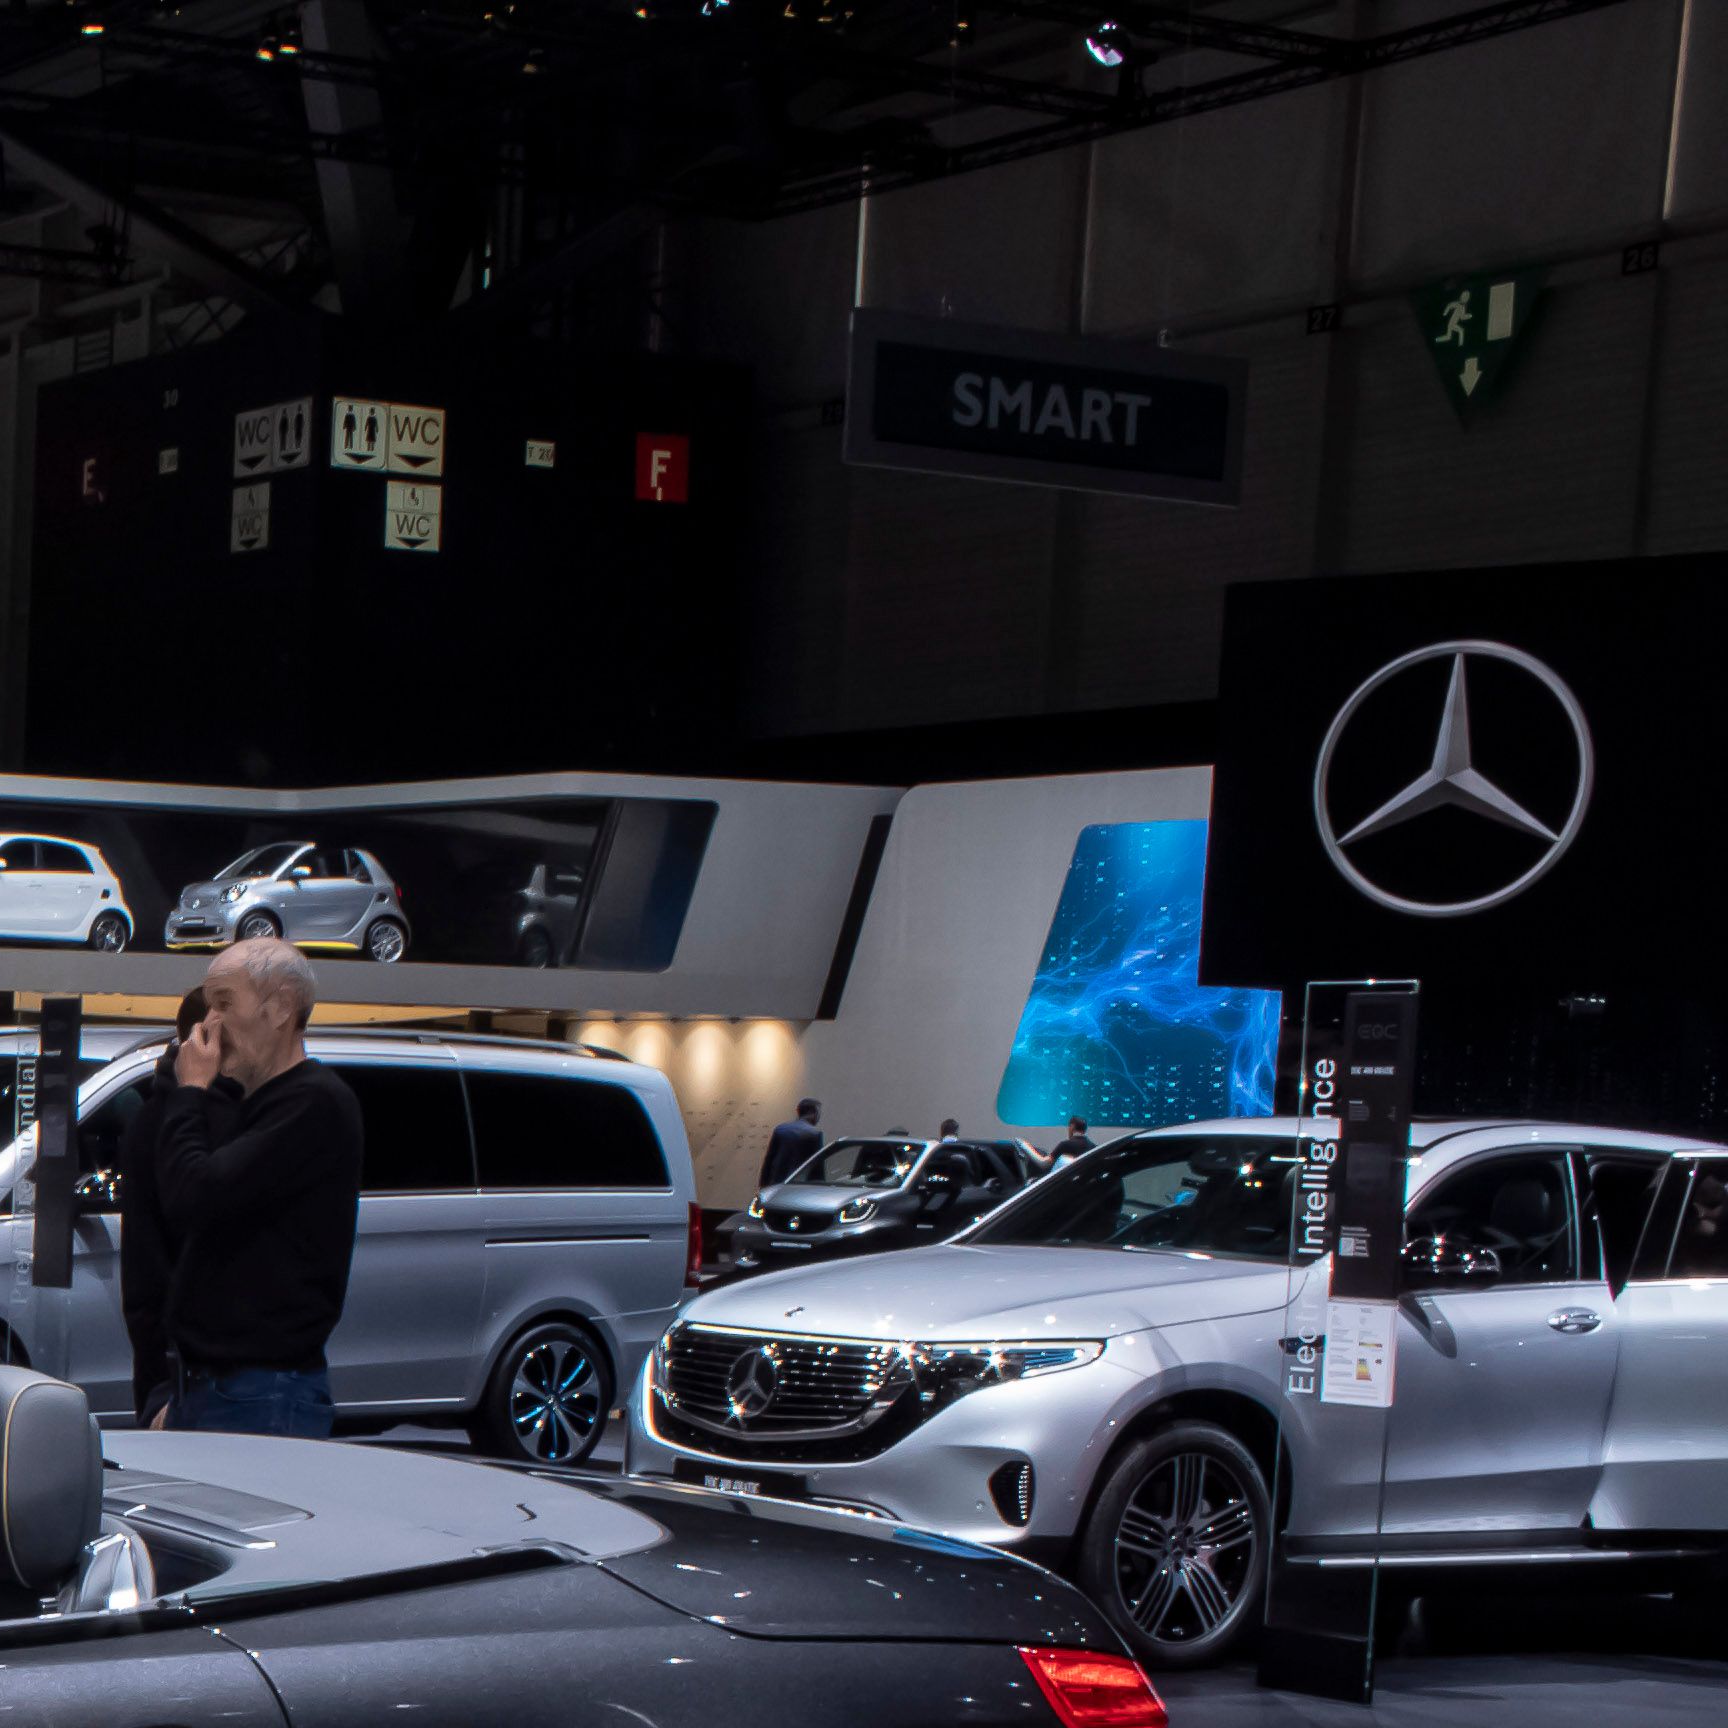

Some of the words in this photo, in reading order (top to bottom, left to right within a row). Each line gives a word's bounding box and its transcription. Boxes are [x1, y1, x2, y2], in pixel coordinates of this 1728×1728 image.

[953, 373, 1151, 446] SMART
[238, 416, 271, 447] WC
[392, 414, 441, 446] WC
[650, 449, 672, 488] F
[394, 514, 432, 538] WC
[1298, 1058, 1338, 1254] Intellignce
